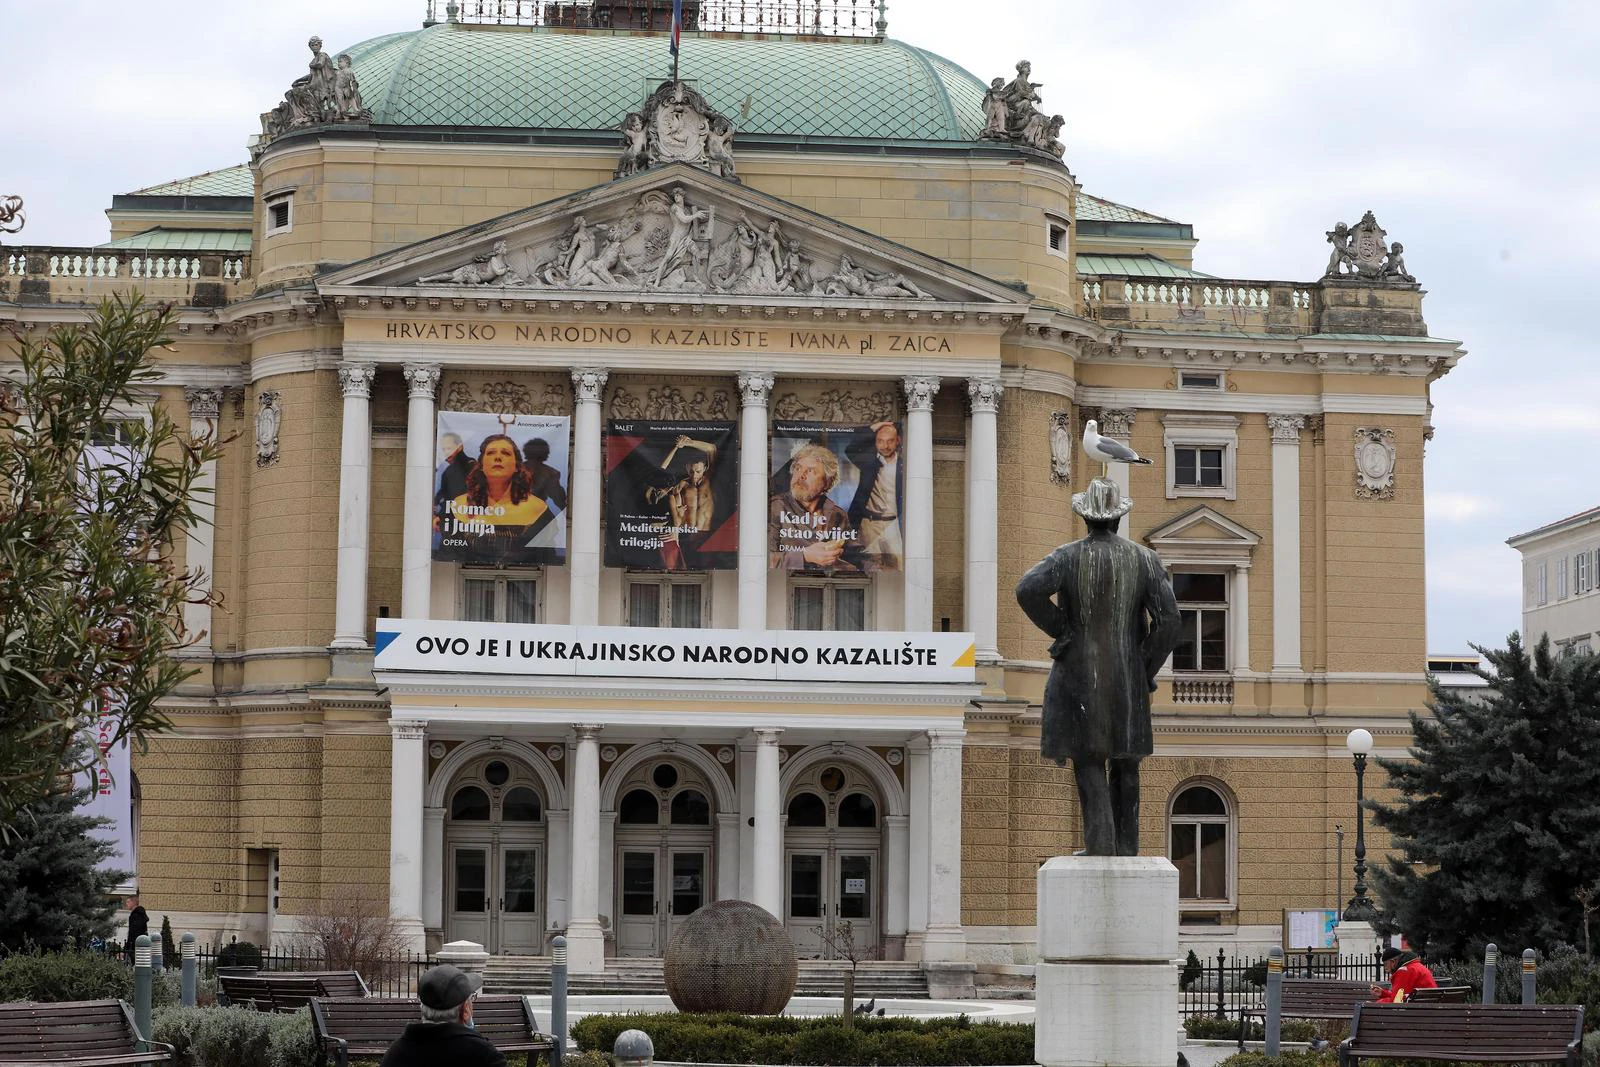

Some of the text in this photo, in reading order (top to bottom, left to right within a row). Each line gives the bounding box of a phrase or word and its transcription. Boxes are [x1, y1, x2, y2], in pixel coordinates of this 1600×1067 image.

[386, 323, 496, 340] HRVATSKO
[515, 325, 631, 343] NARODNO
[650, 328, 768, 347] KAZALIŠTE
[790, 332, 850, 350] IVANA
[888, 335, 952, 352] ZAJCA
[445, 500, 505, 516] Romeo
[780, 511, 827, 528] Kad je
[444, 518, 496, 537] i Julija
[620, 522, 698, 534] Mediteranska
[779, 527, 858, 541] stao svijet
[443, 539, 468, 547] OPERA
[619, 537, 664, 550] trilogija
[779, 544, 806, 552] DRAMA
[416, 636, 937, 666] OVO JE I UKRAJINSKO NARODNO KAZALIŠTE
